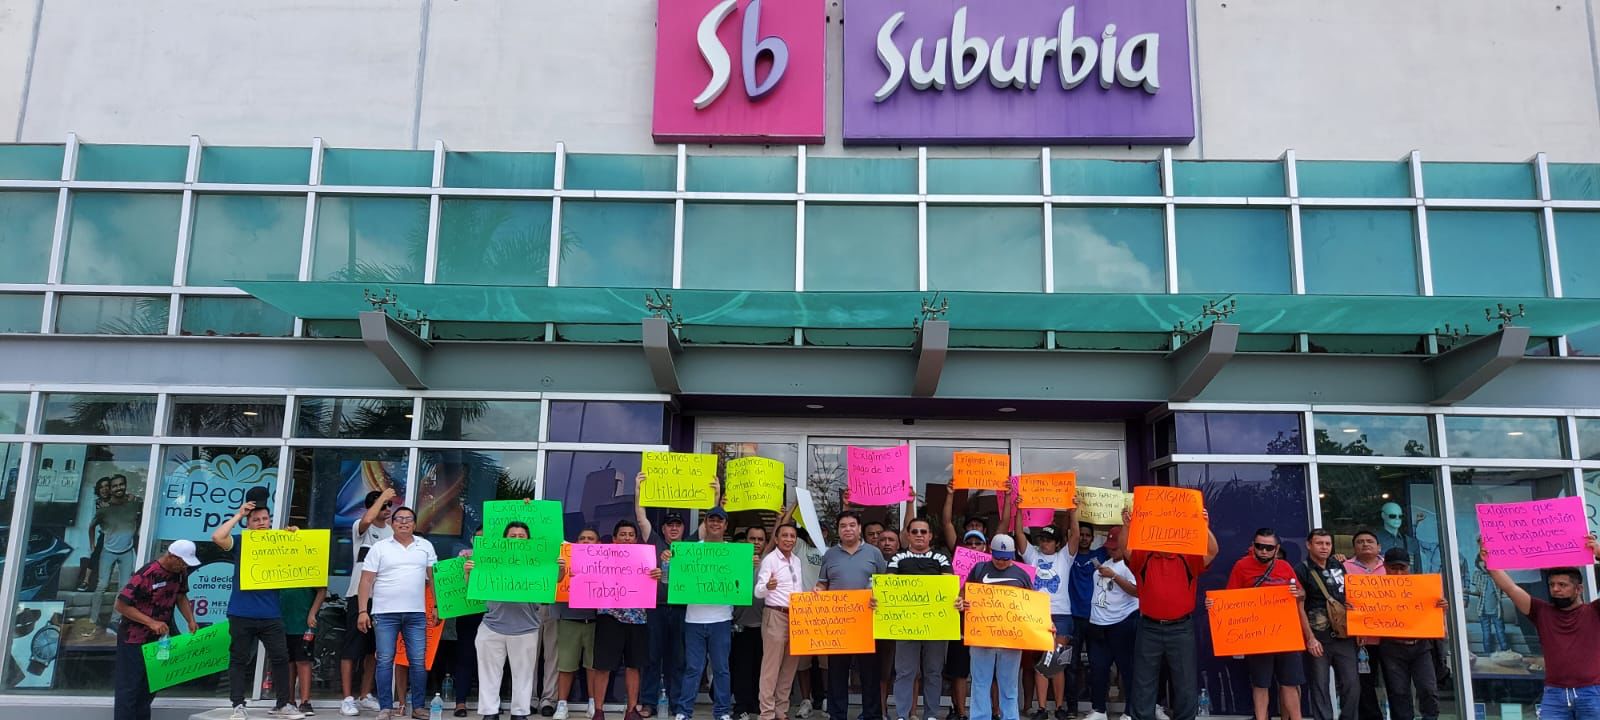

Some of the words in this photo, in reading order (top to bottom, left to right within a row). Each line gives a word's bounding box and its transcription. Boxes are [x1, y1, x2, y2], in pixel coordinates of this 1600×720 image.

[693, 0, 789, 110] Sb
[874, 4, 1160, 102] Suburbia
[647, 452, 688, 464] Exigimos
[694, 455, 702, 463] el
[647, 467, 668, 478] pago
[672, 464, 682, 474] de
[689, 465, 702, 476] las
[167, 484, 184, 499] El
[645, 480, 706, 499] Utilidades
[165, 505, 202, 517] más
[250, 531, 302, 544] Exigimos
[252, 546, 299, 560] garantizar
[304, 545, 318, 555] las
[537, 540, 547, 552] el
[508, 554, 520, 565] de
[526, 554, 540, 566] las
[681, 559, 731, 574] uniformes
[251, 564, 320, 582] Comisiones
[581, 560, 632, 575] uniformes
[673, 579, 686, 591] de
[1348, 575, 1412, 589] Exigimos
[881, 590, 930, 605] Igualdad
[936, 589, 947, 602] de
[968, 584, 1017, 599] Exigimos
[1022, 590, 1030, 600] la
[1400, 589, 1412, 598] de
[832, 594, 849, 604] que
[1009, 600, 1024, 610] del
[939, 608, 947, 617] el
[1415, 602, 1424, 611] el
[791, 618, 801, 626] de
[966, 611, 1004, 623] Contrato
[970, 628, 982, 636] de
[986, 625, 1023, 640] Trabajo
